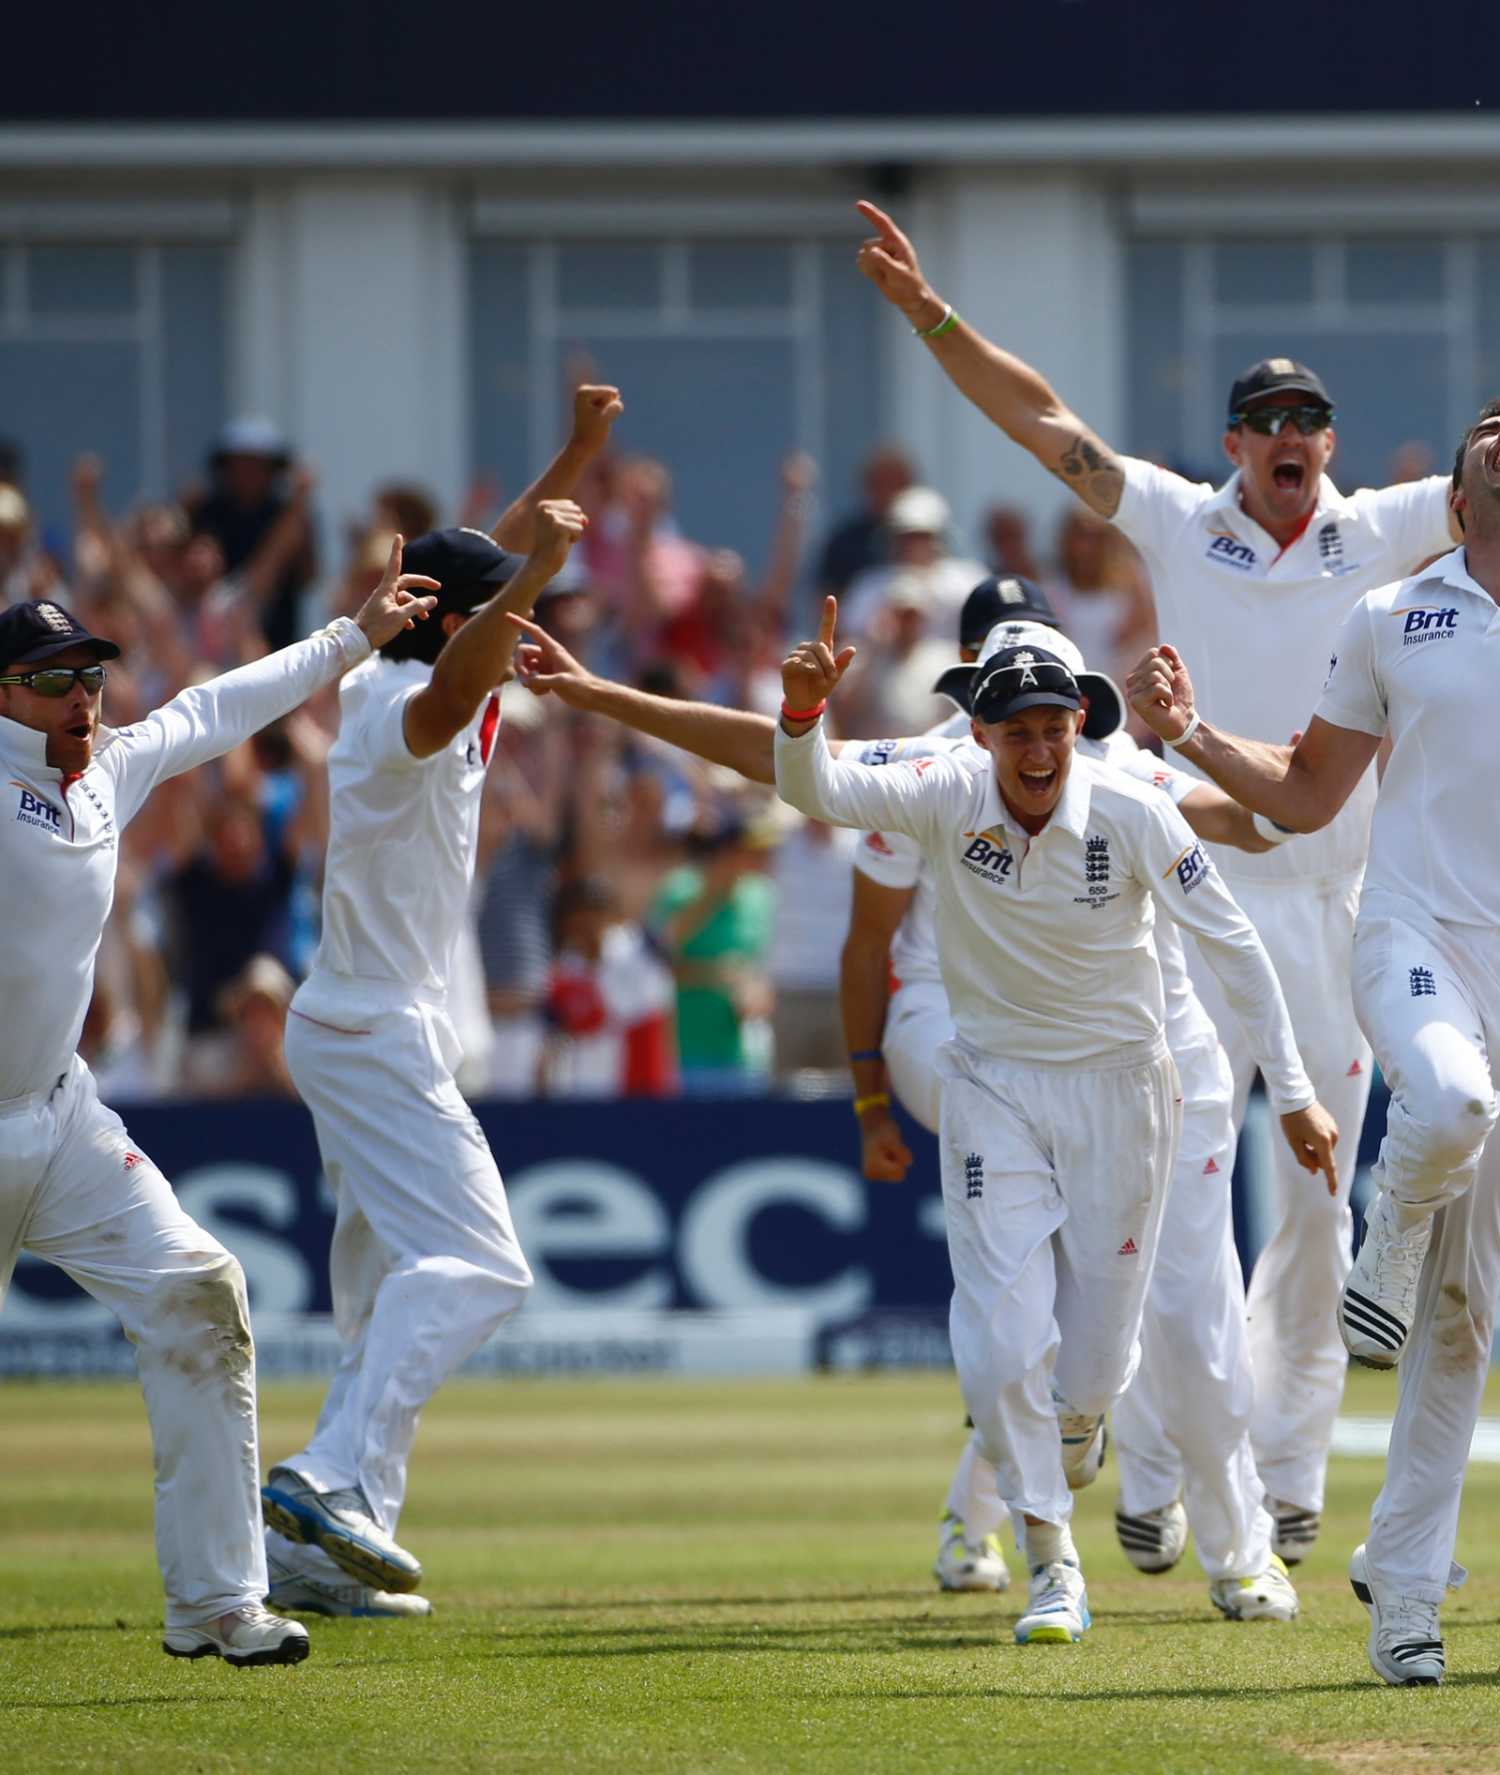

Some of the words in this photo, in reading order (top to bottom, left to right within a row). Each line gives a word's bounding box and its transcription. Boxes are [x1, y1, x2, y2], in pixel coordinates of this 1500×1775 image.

[1404, 607, 1460, 633] Brit
[1403, 629, 1455, 646] Insurance
[20, 789, 62, 827] Brit
[964, 838, 1014, 876] Brit
